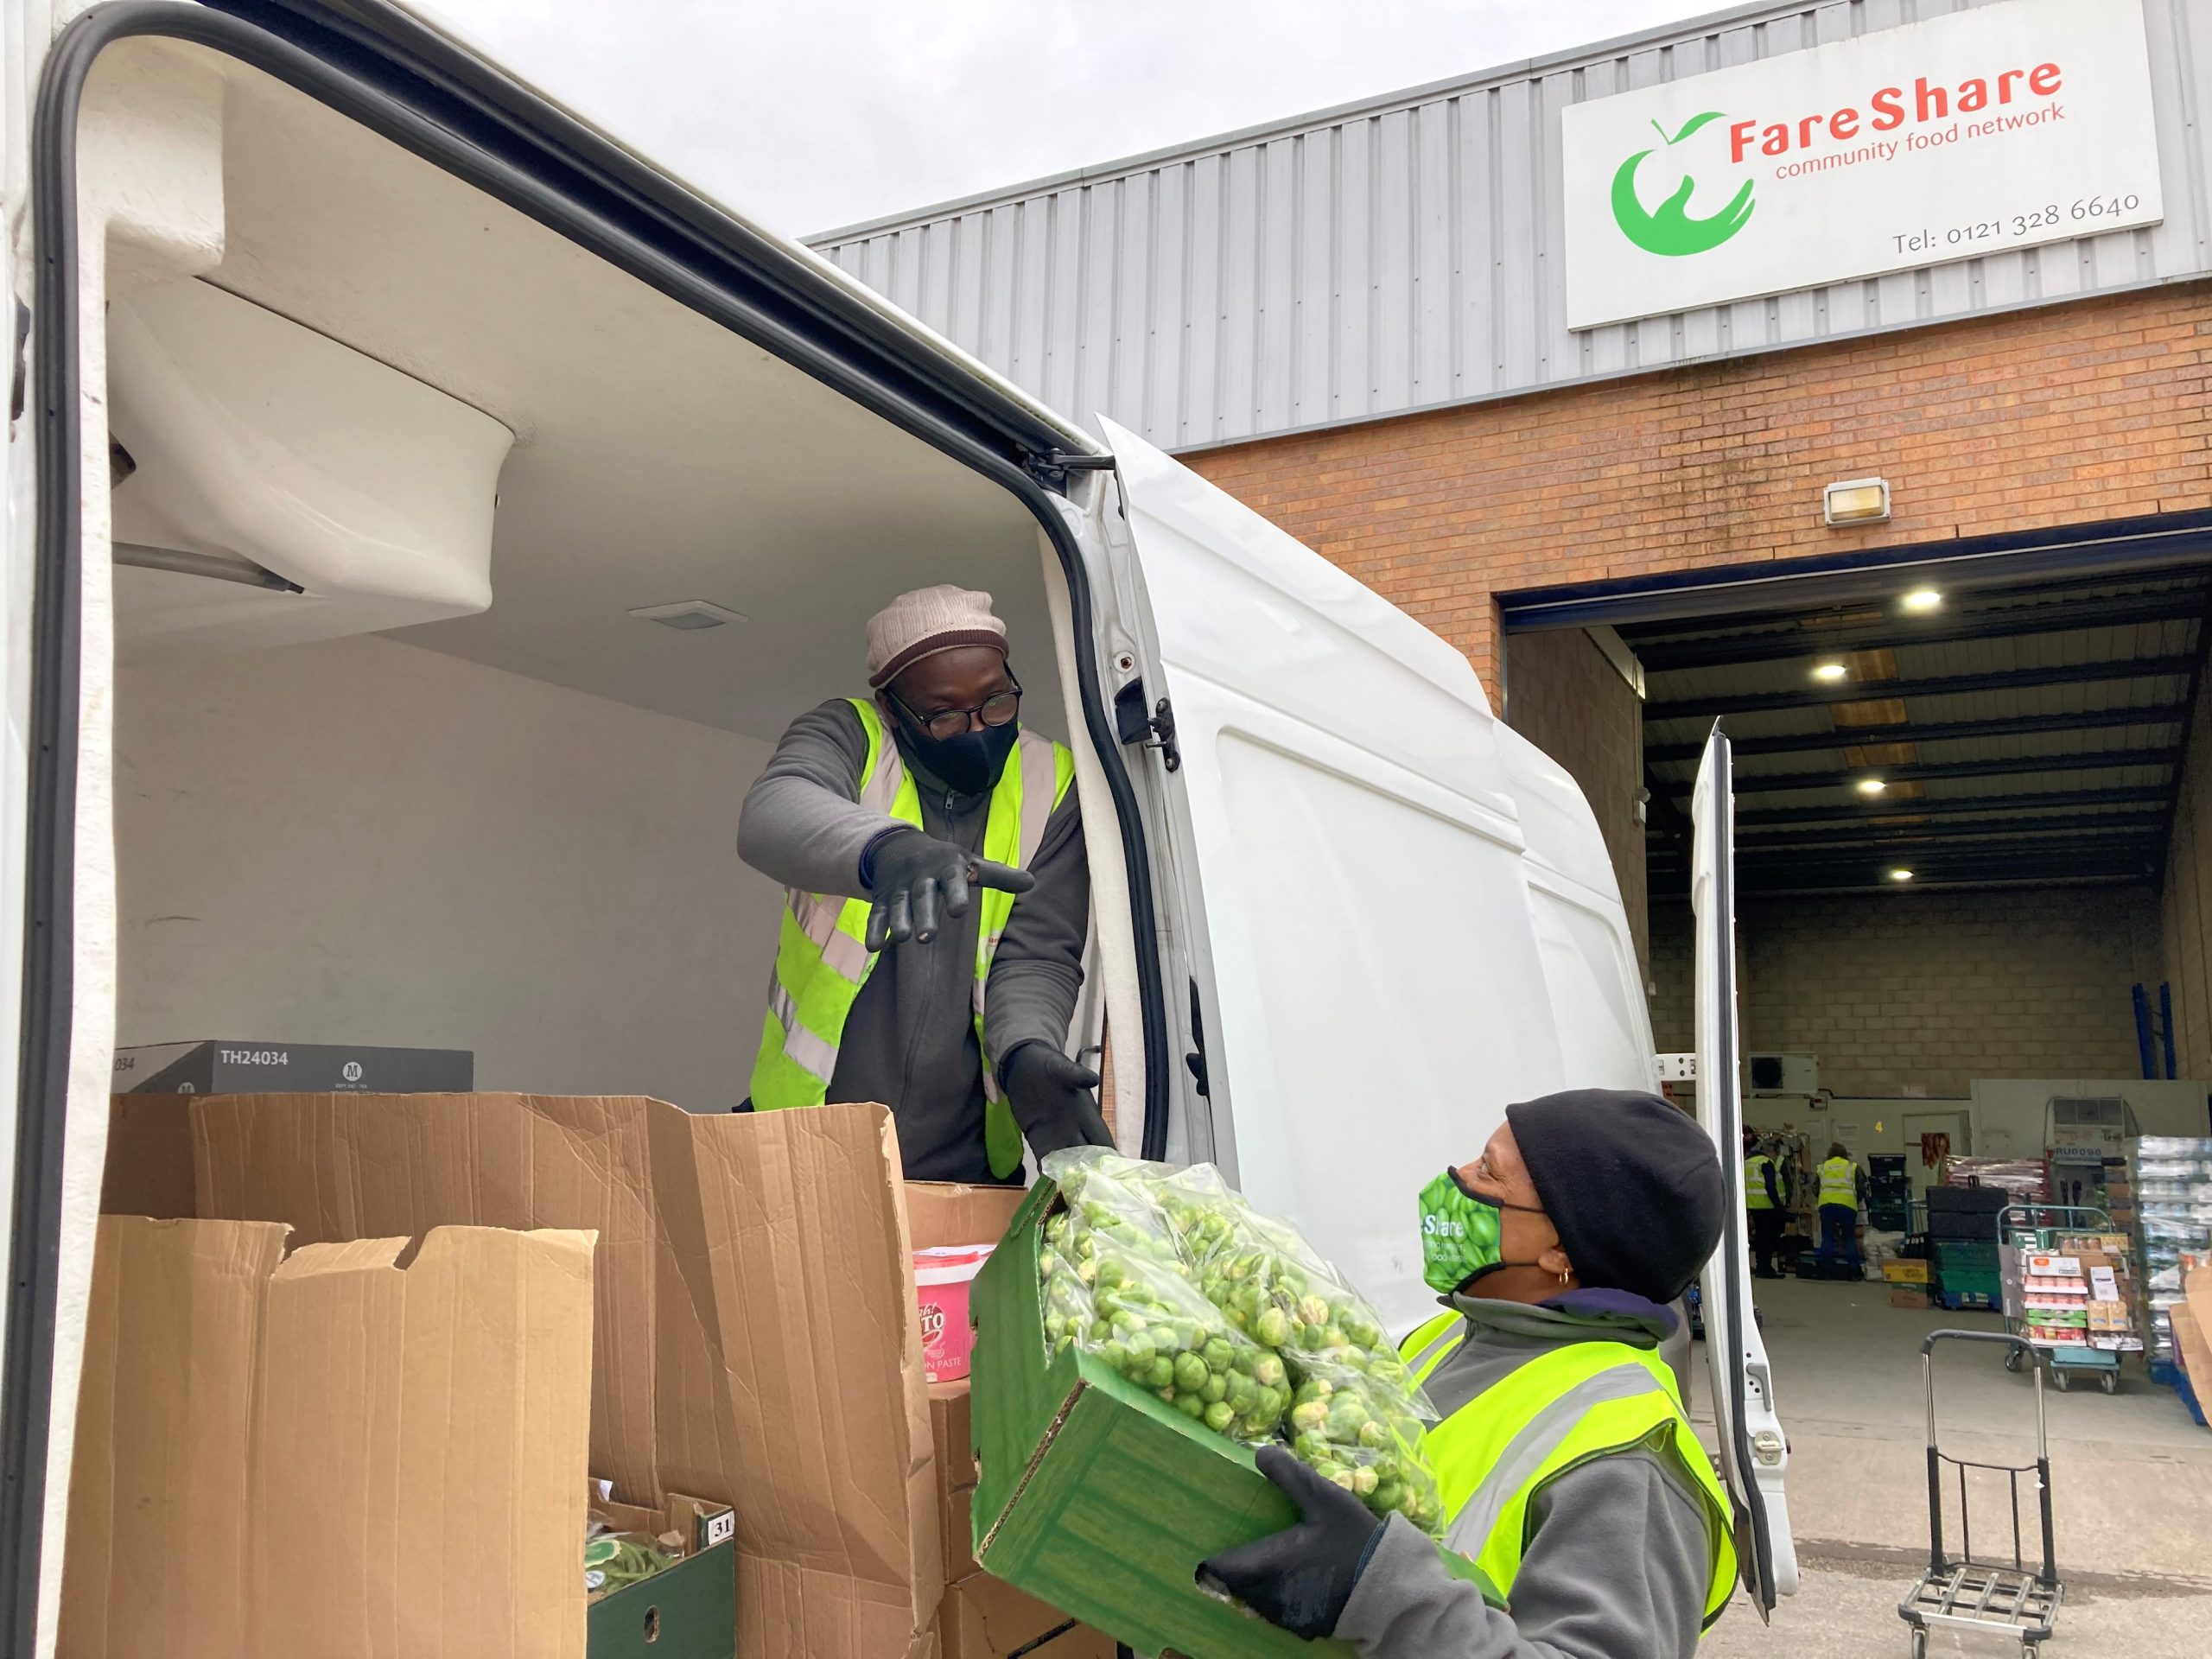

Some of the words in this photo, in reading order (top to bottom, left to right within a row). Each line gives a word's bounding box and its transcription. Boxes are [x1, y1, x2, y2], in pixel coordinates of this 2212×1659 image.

[1776, 140, 1898, 180] community
[1906, 124, 1959, 151] food
[1967, 102, 2065, 138] network
[1892, 229, 1936, 254] Tel:
[1947, 220, 2001, 244] 0121
[2012, 205, 2060, 236] 328
[2071, 194, 2139, 220] 6640
[221, 1050, 289, 1065] TH24034
[346, 1065, 359, 1077] M
[1874, 1121, 1884, 1134] 4
[938, 1357, 961, 1369] PASTE
[715, 1518, 731, 1536] 31
